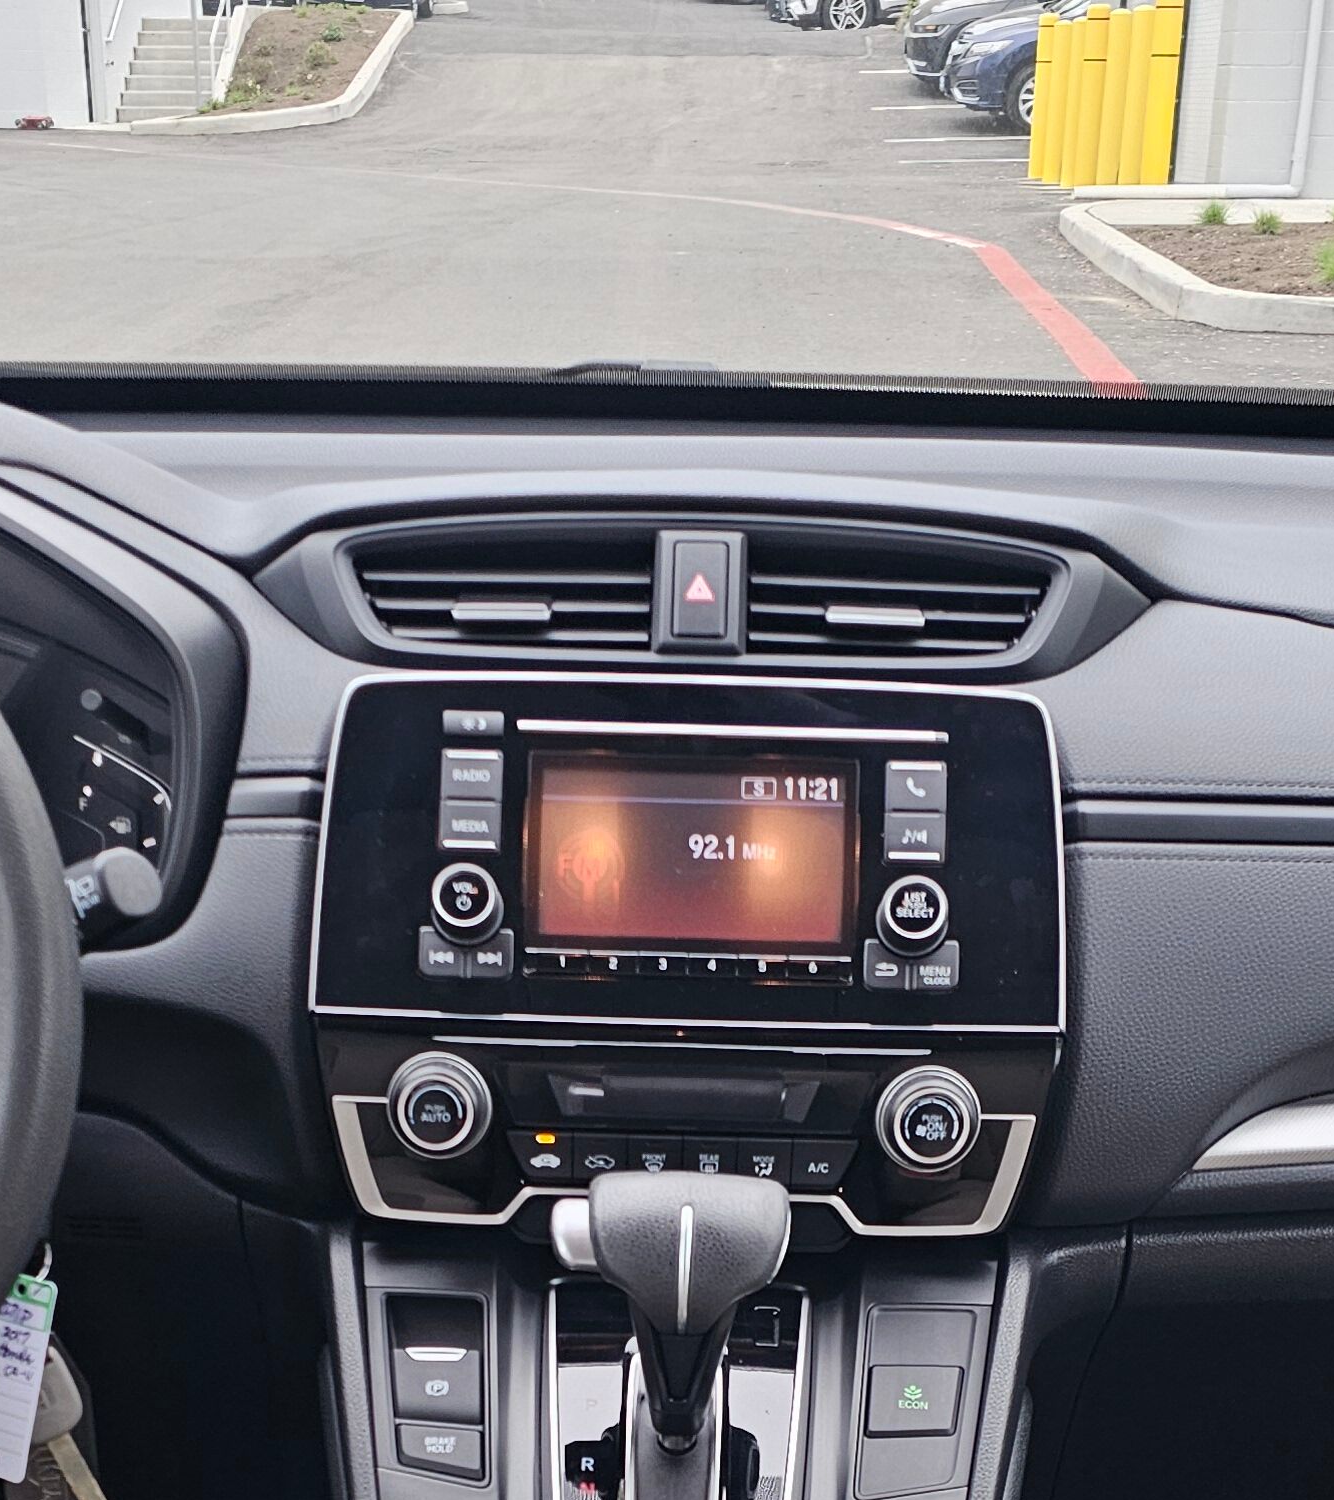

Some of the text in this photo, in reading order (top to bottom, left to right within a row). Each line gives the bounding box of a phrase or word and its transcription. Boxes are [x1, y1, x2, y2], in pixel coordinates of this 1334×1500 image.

[452, 768, 491, 783] RADIO
[784, 776, 839, 801] 11:21
[451, 819, 490, 834] MEDIA
[687, 833, 736, 861] 92.1
[895, 906, 935, 919] SELECT
[919, 965, 952, 977] MENU
[419, 1112, 451, 1123] AUTO
[921, 1114, 943, 1123] PUSH
[926, 1131, 947, 1141] OFF
[641, 1153, 667, 1163] FRONT
[807, 1162, 830, 1174] A/C
[898, 1399, 929, 1410] ECON
[581, 1457, 595, 1472] R
